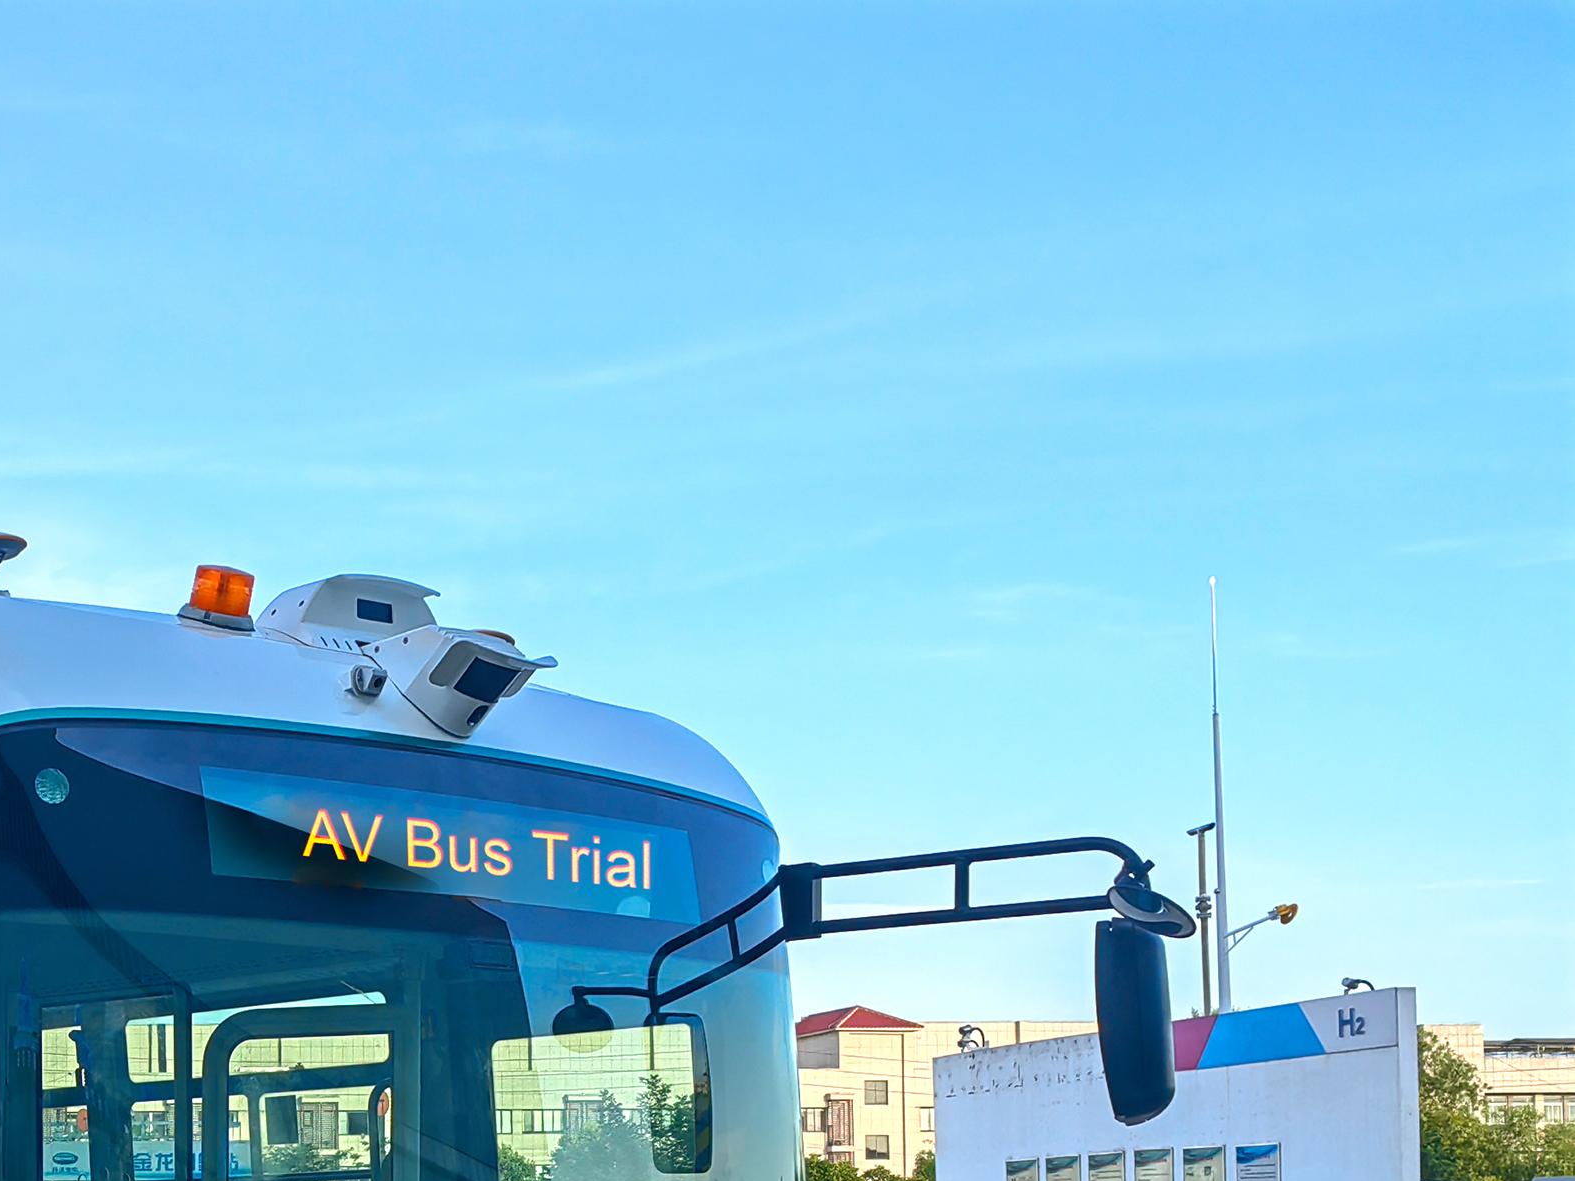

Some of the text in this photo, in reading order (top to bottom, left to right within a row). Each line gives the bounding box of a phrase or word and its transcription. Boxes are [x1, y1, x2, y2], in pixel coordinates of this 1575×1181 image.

[302, 809, 651, 890] AV Bus Trial
